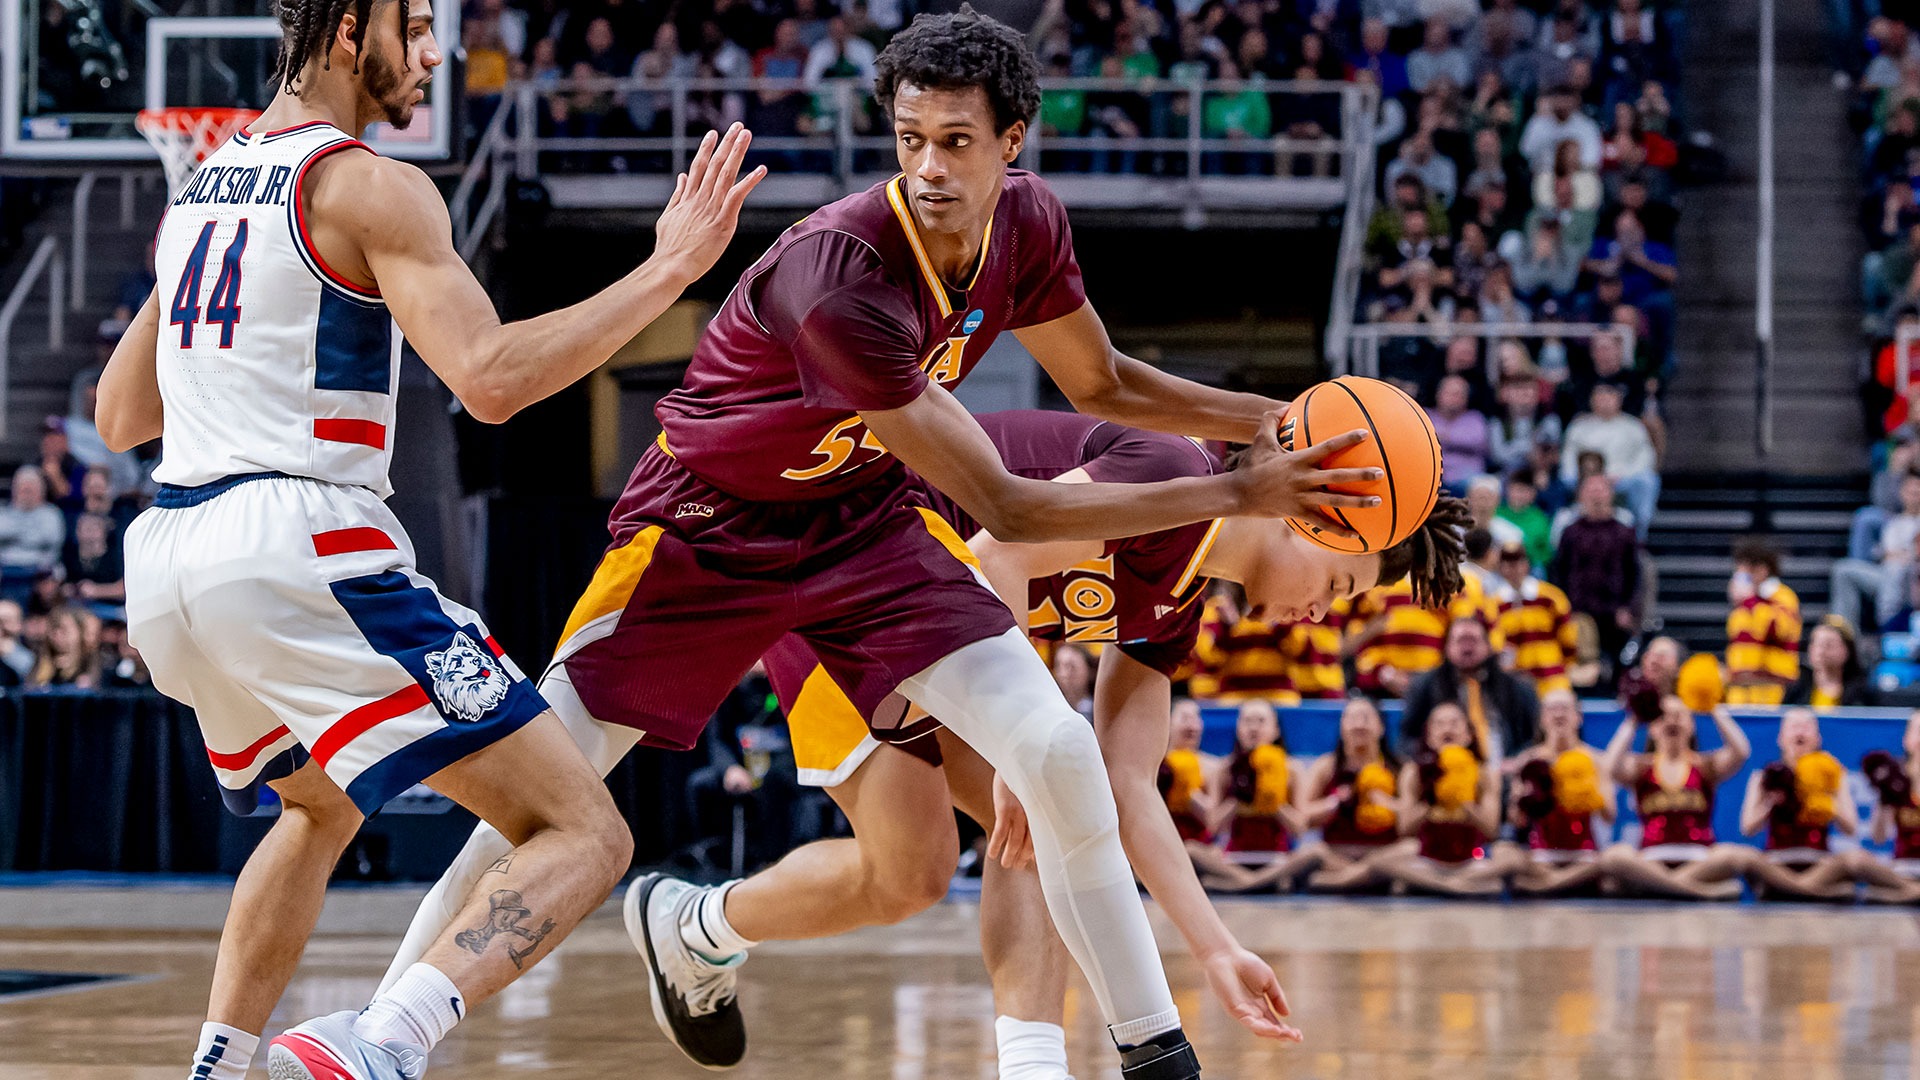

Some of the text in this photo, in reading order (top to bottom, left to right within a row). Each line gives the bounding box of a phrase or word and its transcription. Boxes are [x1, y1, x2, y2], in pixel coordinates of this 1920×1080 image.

[174, 165, 292, 206] JACKSON JR.
[169, 218, 248, 349] 44
[675, 503, 714, 518] MAAC
[1062, 553, 1119, 643] ION
